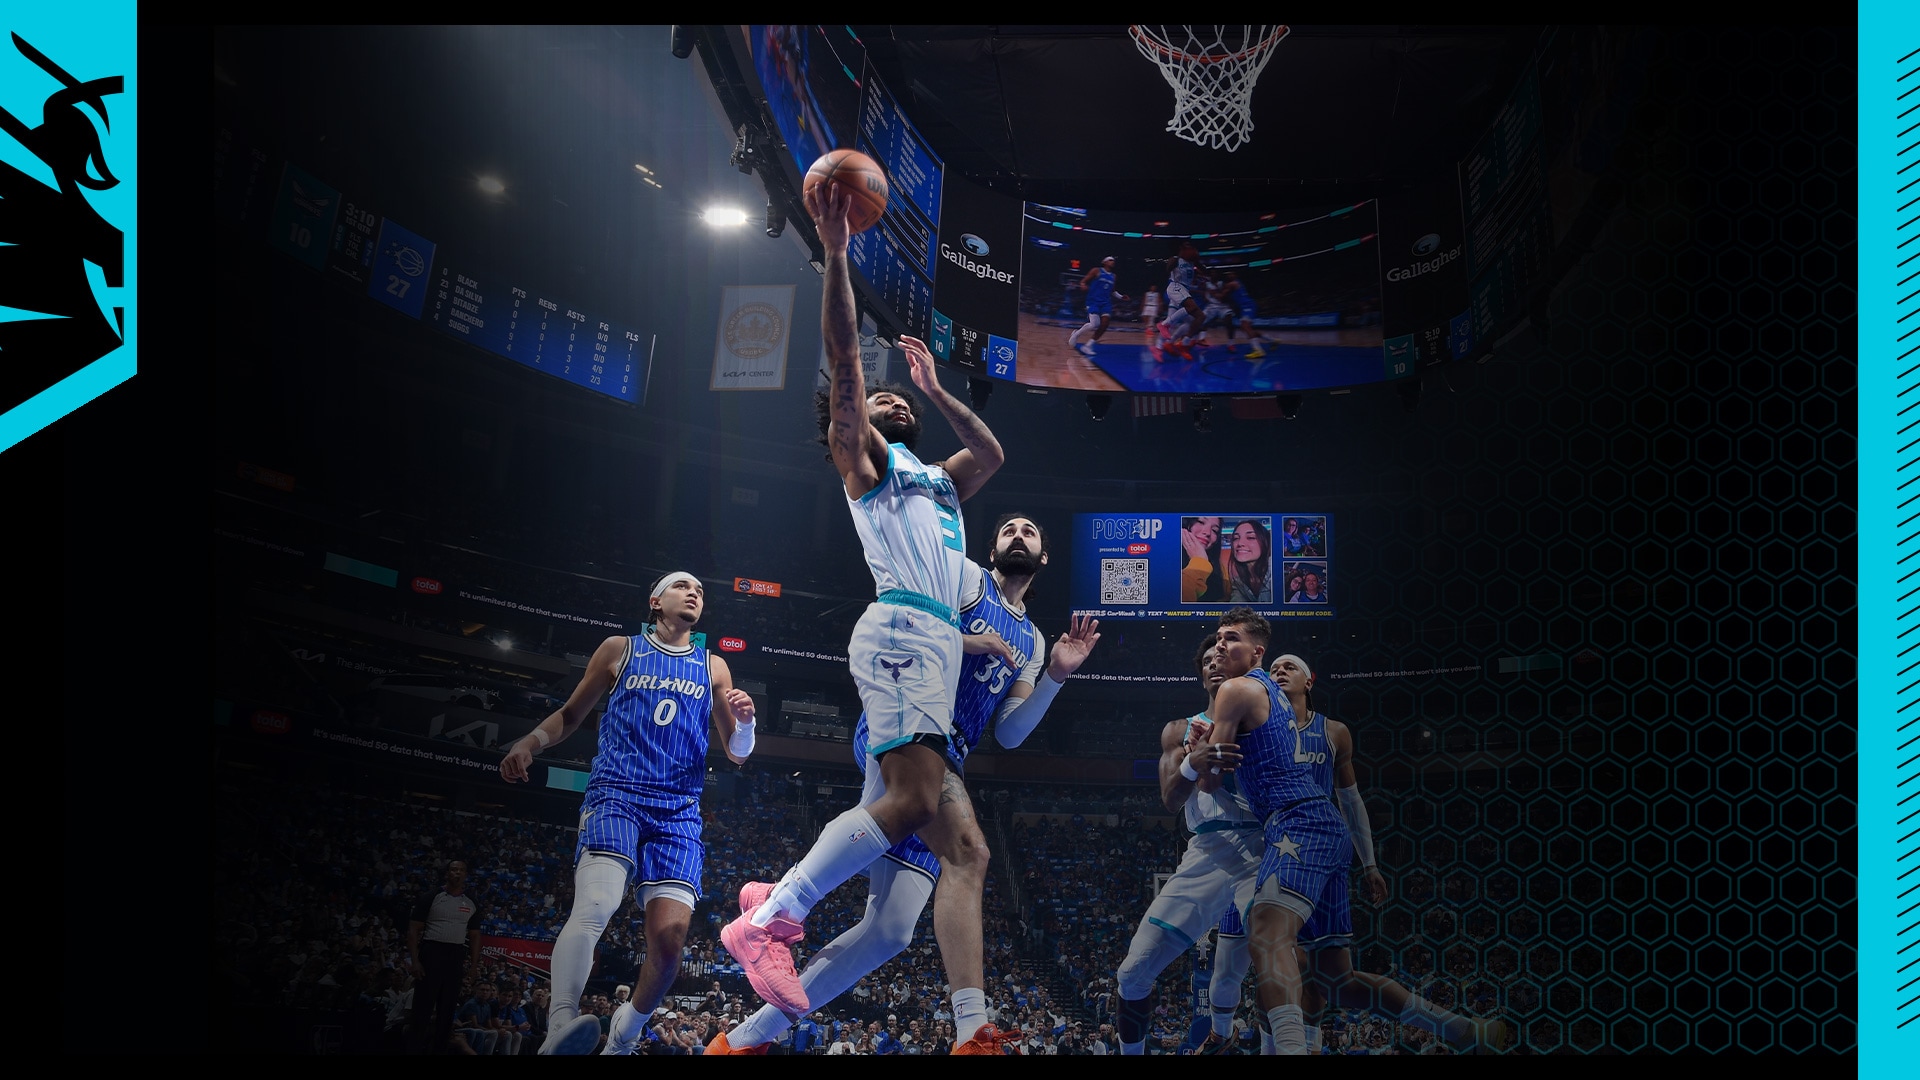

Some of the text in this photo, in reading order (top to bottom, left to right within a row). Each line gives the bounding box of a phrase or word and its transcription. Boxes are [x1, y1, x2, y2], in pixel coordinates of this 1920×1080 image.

[345, 202, 375, 228] 3:10
[290, 222, 312, 249] 10
[940, 243, 1015, 284] Gallagher
[1386, 244, 1462, 282] Gallagher
[386, 274, 411, 299] 27
[440, 279, 449, 289] 23
[455, 285, 464, 297] DA
[465, 289, 483, 304] SILVA
[512, 310, 518, 319] 0
[541, 322, 547, 331] 0
[457, 273, 478, 290] BLACK
[514, 299, 520, 308] 0
[597, 332, 608, 343] 0/0
[512, 286, 640, 342] PTS REBS ASTS FG FLS
[436, 300, 442, 310] 5
[450, 307, 484, 328] BANCHERO
[566, 354, 571, 363] 3
[438, 289, 447, 300] 35
[452, 296, 479, 314] BITADZE
[593, 353, 605, 364] 0/0
[961, 328, 977, 340] 3:10
[433, 312, 439, 321] 4
[448, 319, 470, 335] SUGGS
[506, 343, 512, 352] 4
[535, 355, 541, 364] 2
[564, 365, 570, 374] 2
[590, 375, 601, 385] 2/3
[863, 352, 879, 362] CUP
[935, 339, 944, 354] 10
[995, 363, 1008, 375] 27
[1393, 362, 1406, 374] 10
[1092, 518, 1163, 540] POST UP
[1099, 546, 1119, 554] presented
[416, 579, 623, 630] total It's unlimited 5G data that won't slow you down
[722, 638, 743, 649] total
[761, 645, 773, 653] It's
[773, 647, 805, 657] unlimited
[816, 653, 832, 661] data
[833, 655, 848, 663] that
[336, 656, 353, 668] The
[354, 661, 387, 675] all-new
[973, 653, 1013, 694] 35
[1341, 671, 1372, 679] unlimited
[1400, 669, 1415, 677] that
[1415, 668, 1435, 676] won't
[653, 697, 678, 727] 0
[256, 712, 499, 772] total It's unlimited 5G data that won't slow you
[510, 950, 525, 958] Ana
[1198, 989, 1208, 997] GET
[1198, 998, 1208, 1006] THE
